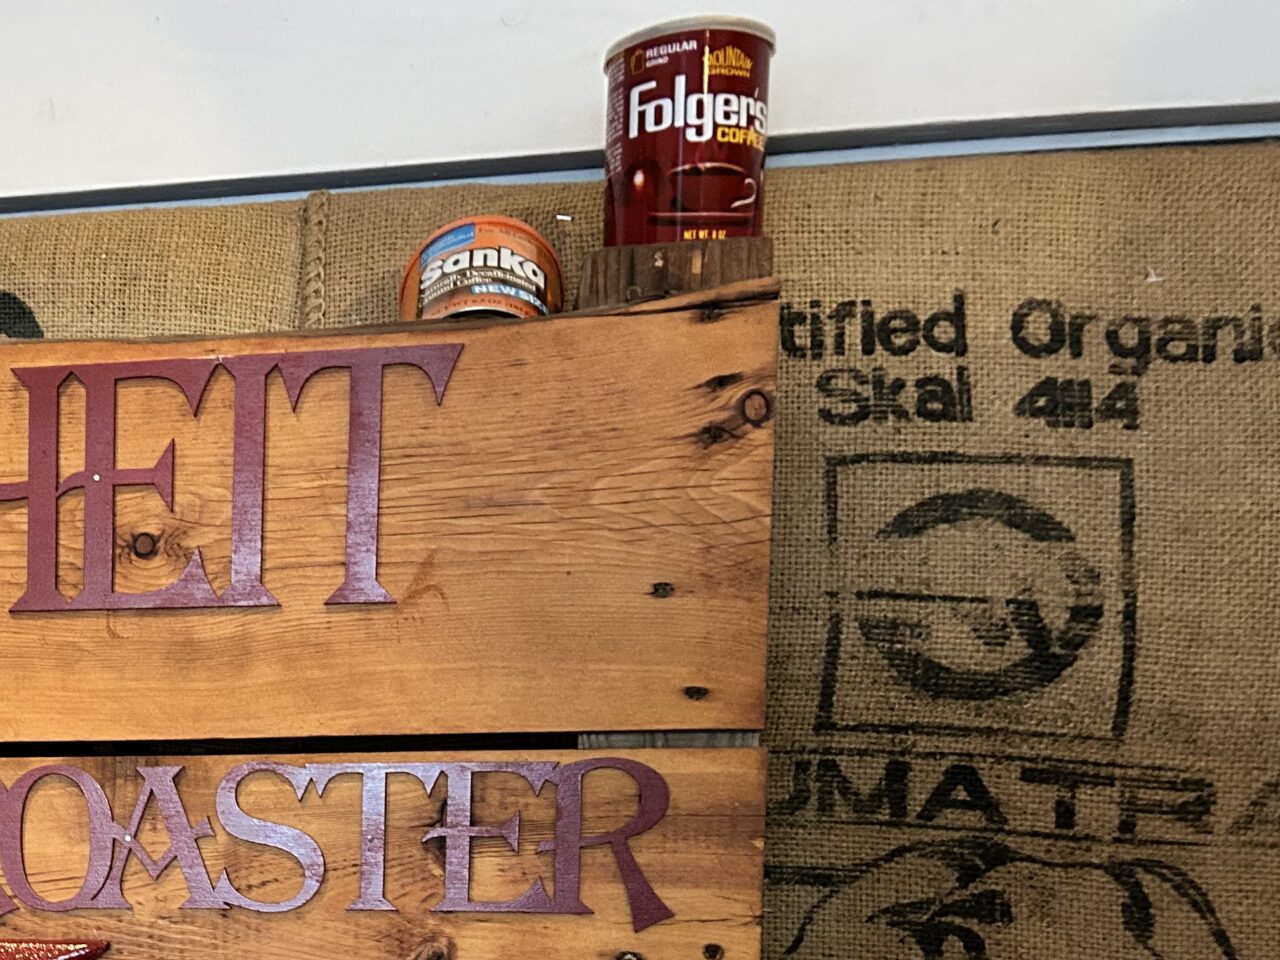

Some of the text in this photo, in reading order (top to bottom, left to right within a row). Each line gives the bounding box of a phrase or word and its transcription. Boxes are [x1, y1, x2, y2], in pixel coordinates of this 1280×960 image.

[646, 40, 697, 57] REGULAR
[629, 74, 767, 142] Folger's
[420, 246, 545, 290] Sanka
[816, 366, 974, 427] Skal
